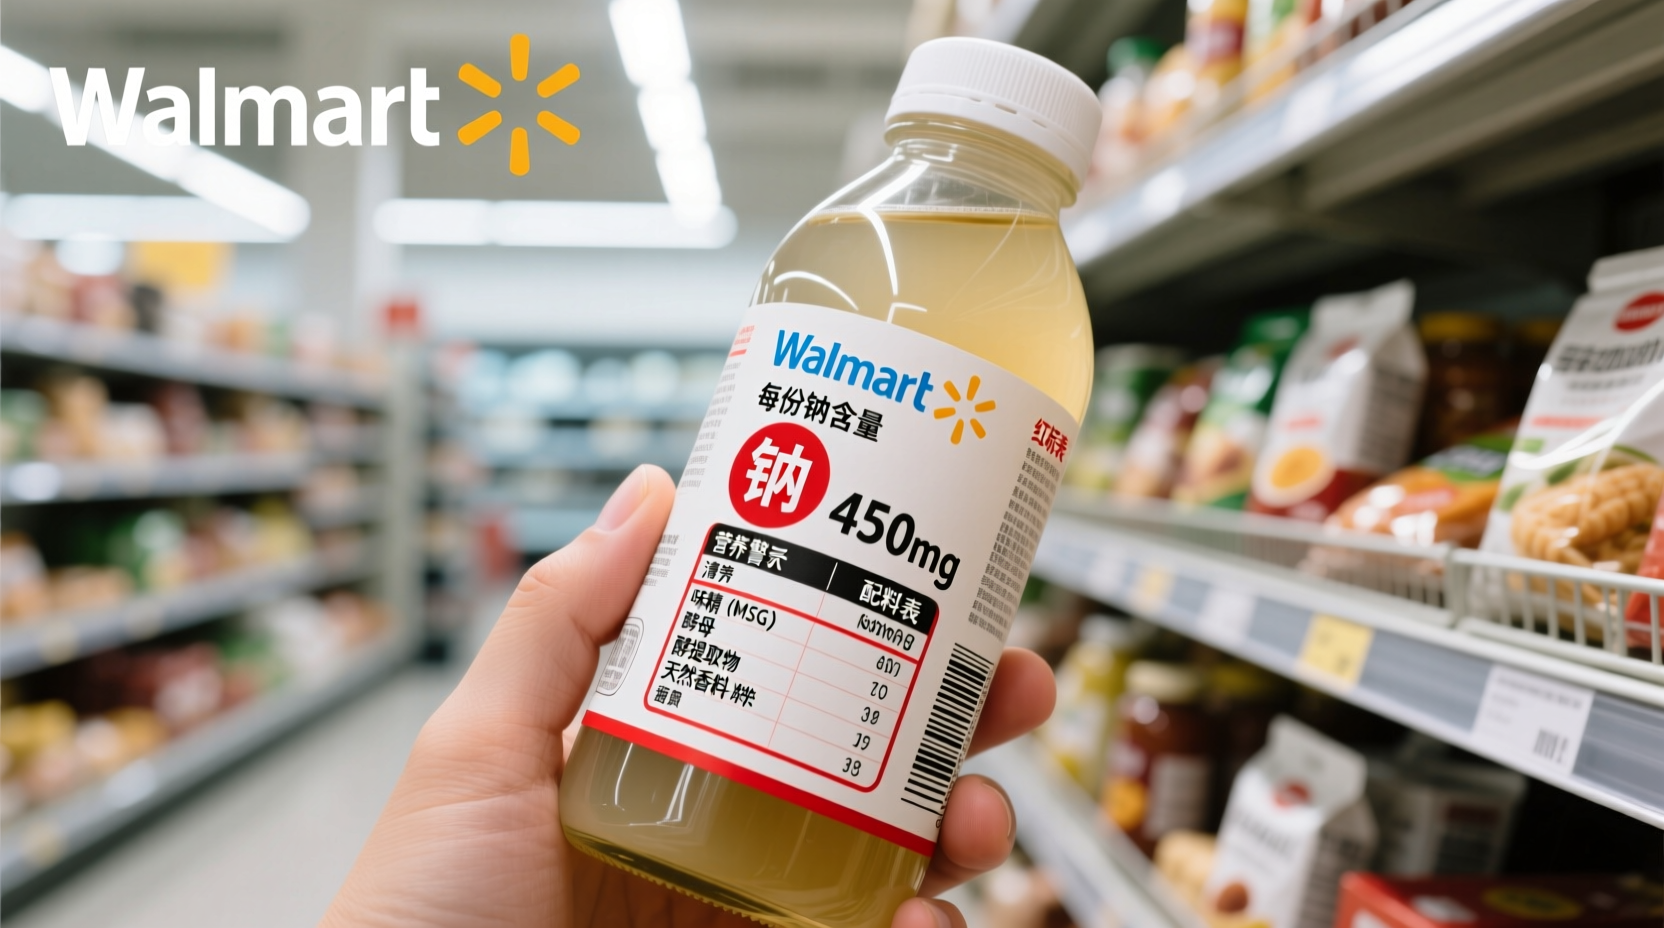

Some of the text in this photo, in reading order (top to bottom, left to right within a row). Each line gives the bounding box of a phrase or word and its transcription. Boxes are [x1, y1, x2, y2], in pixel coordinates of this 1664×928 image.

[773, 329, 934, 413] Walmart
[758, 382, 883, 442] 每份钠含量
[744, 437, 813, 513] 钠
[829, 492, 960, 591] 450mg
[727, 598, 777, 631] (MSG)
[859, 579, 922, 625] 配料表
[660, 660, 730, 699] 天然香料
